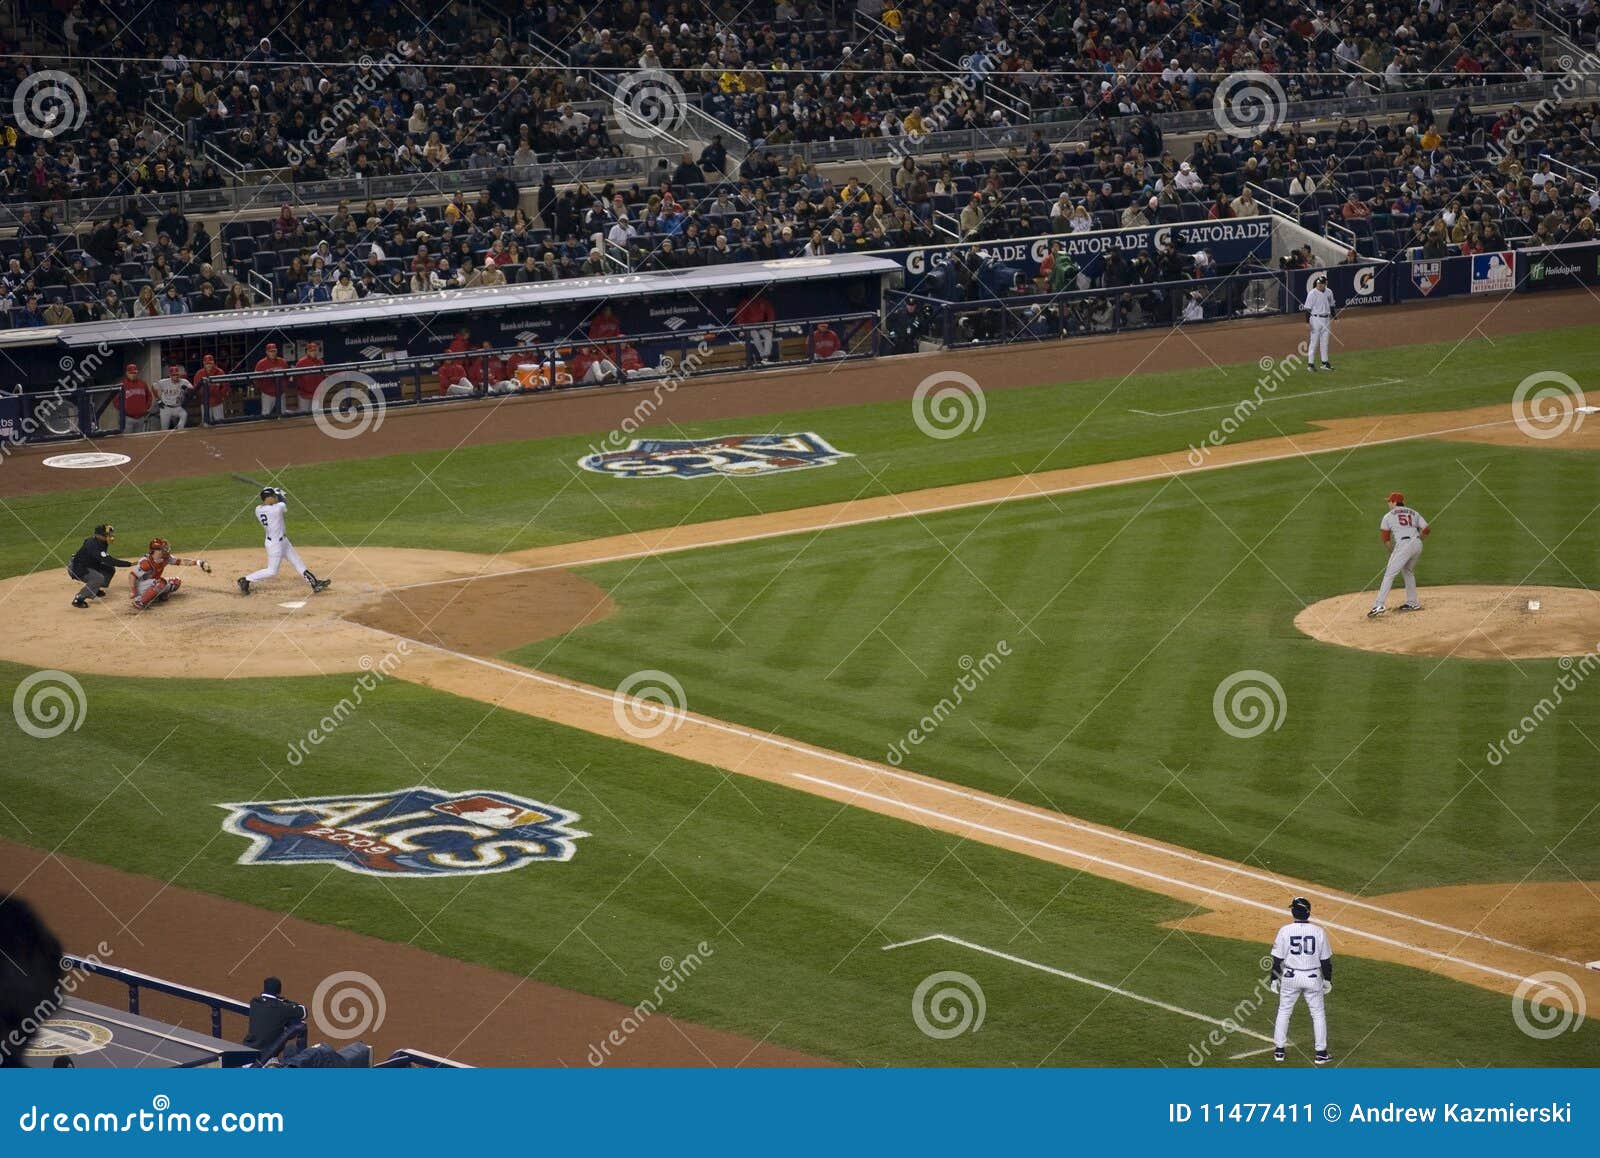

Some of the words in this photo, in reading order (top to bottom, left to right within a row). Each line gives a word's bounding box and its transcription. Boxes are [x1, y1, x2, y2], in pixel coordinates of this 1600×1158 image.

[1413, 263, 1439, 274] MLB
[1345, 296, 1383, 306] GATORADE
[260, 513, 268, 527] 2
[1398, 514, 1413, 527] 51
[271, 799, 547, 868] ALCS
[303, 827, 391, 855] 2009
[1290, 936, 1315, 955] 50
